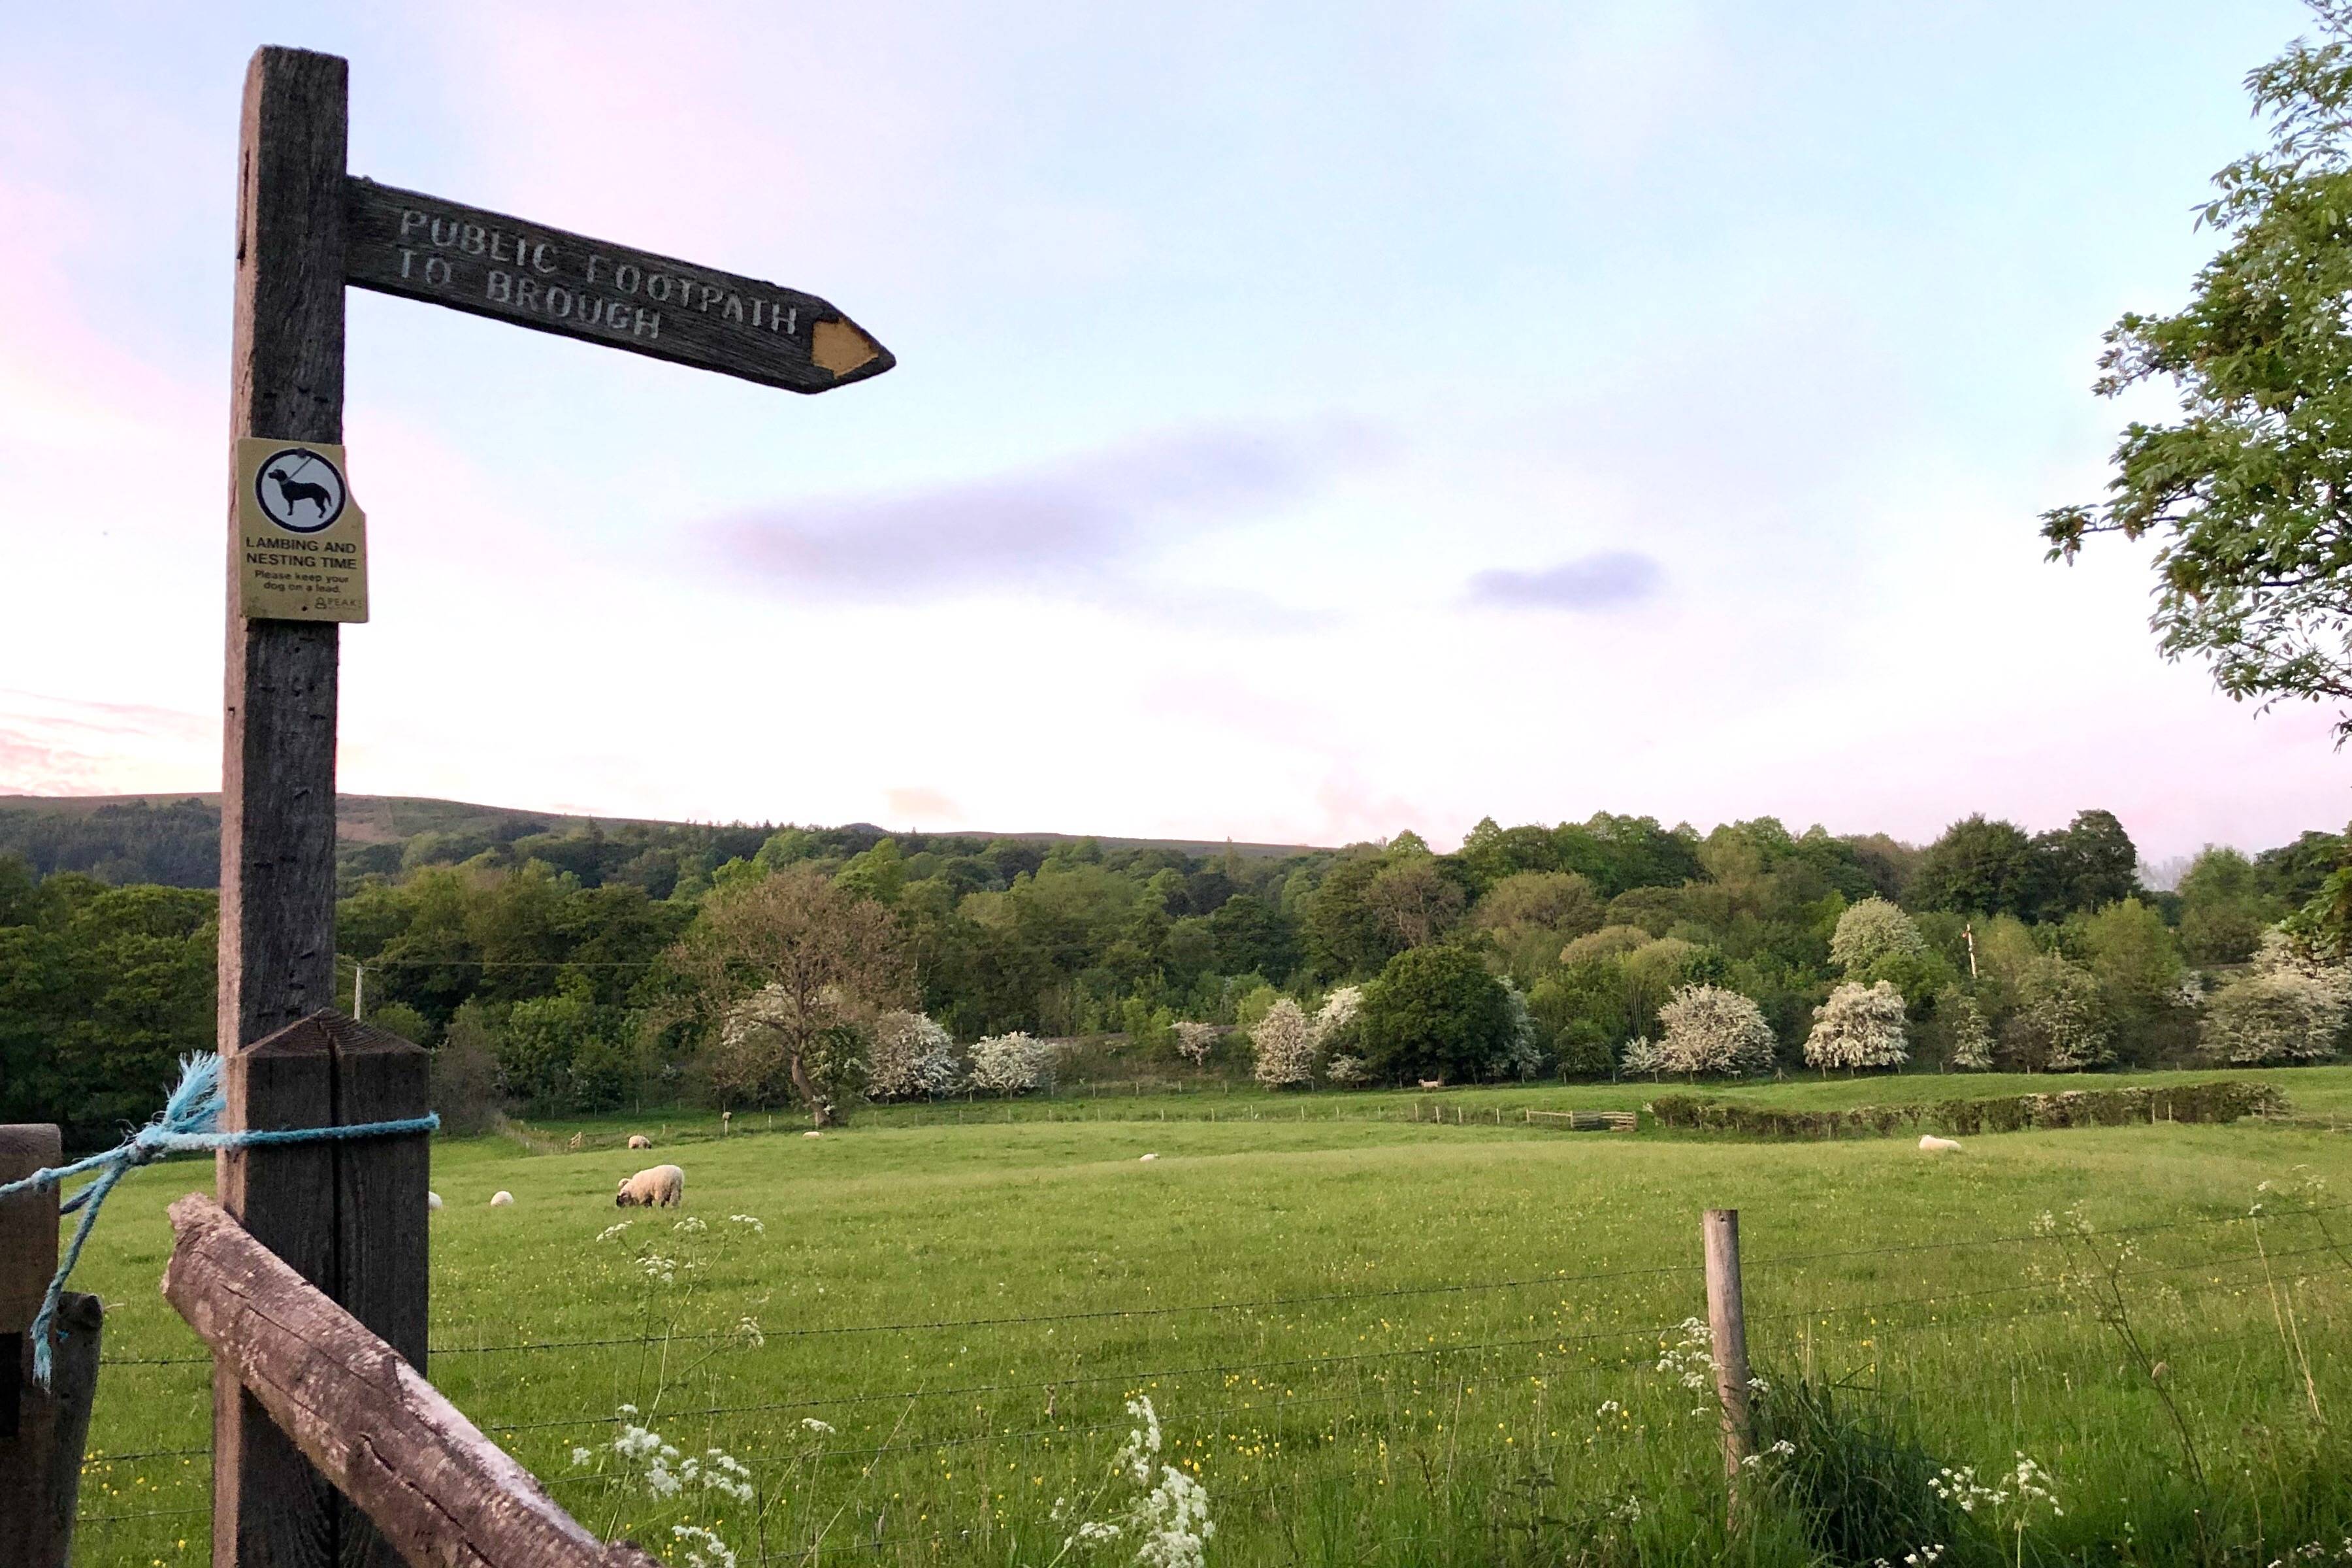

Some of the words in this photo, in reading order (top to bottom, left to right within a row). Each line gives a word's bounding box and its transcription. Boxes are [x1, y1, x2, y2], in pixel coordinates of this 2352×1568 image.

[400, 209, 557, 273] PUBLIC
[587, 254, 797, 335] FOOTPATH
[399, 248, 452, 285] TO
[486, 270, 661, 338] BROUGH
[246, 536, 319, 551] LAMBING
[324, 542, 357, 553] AND
[246, 553, 316, 567] NESTING
[320, 557, 357, 570] TIME
[255, 570, 292, 580] Please
[295, 572, 322, 582] keep
[326, 575, 350, 583] your
[263, 581, 286, 592] dog
[316, 583, 341, 593] lead.
[327, 597, 357, 607] PEAK
